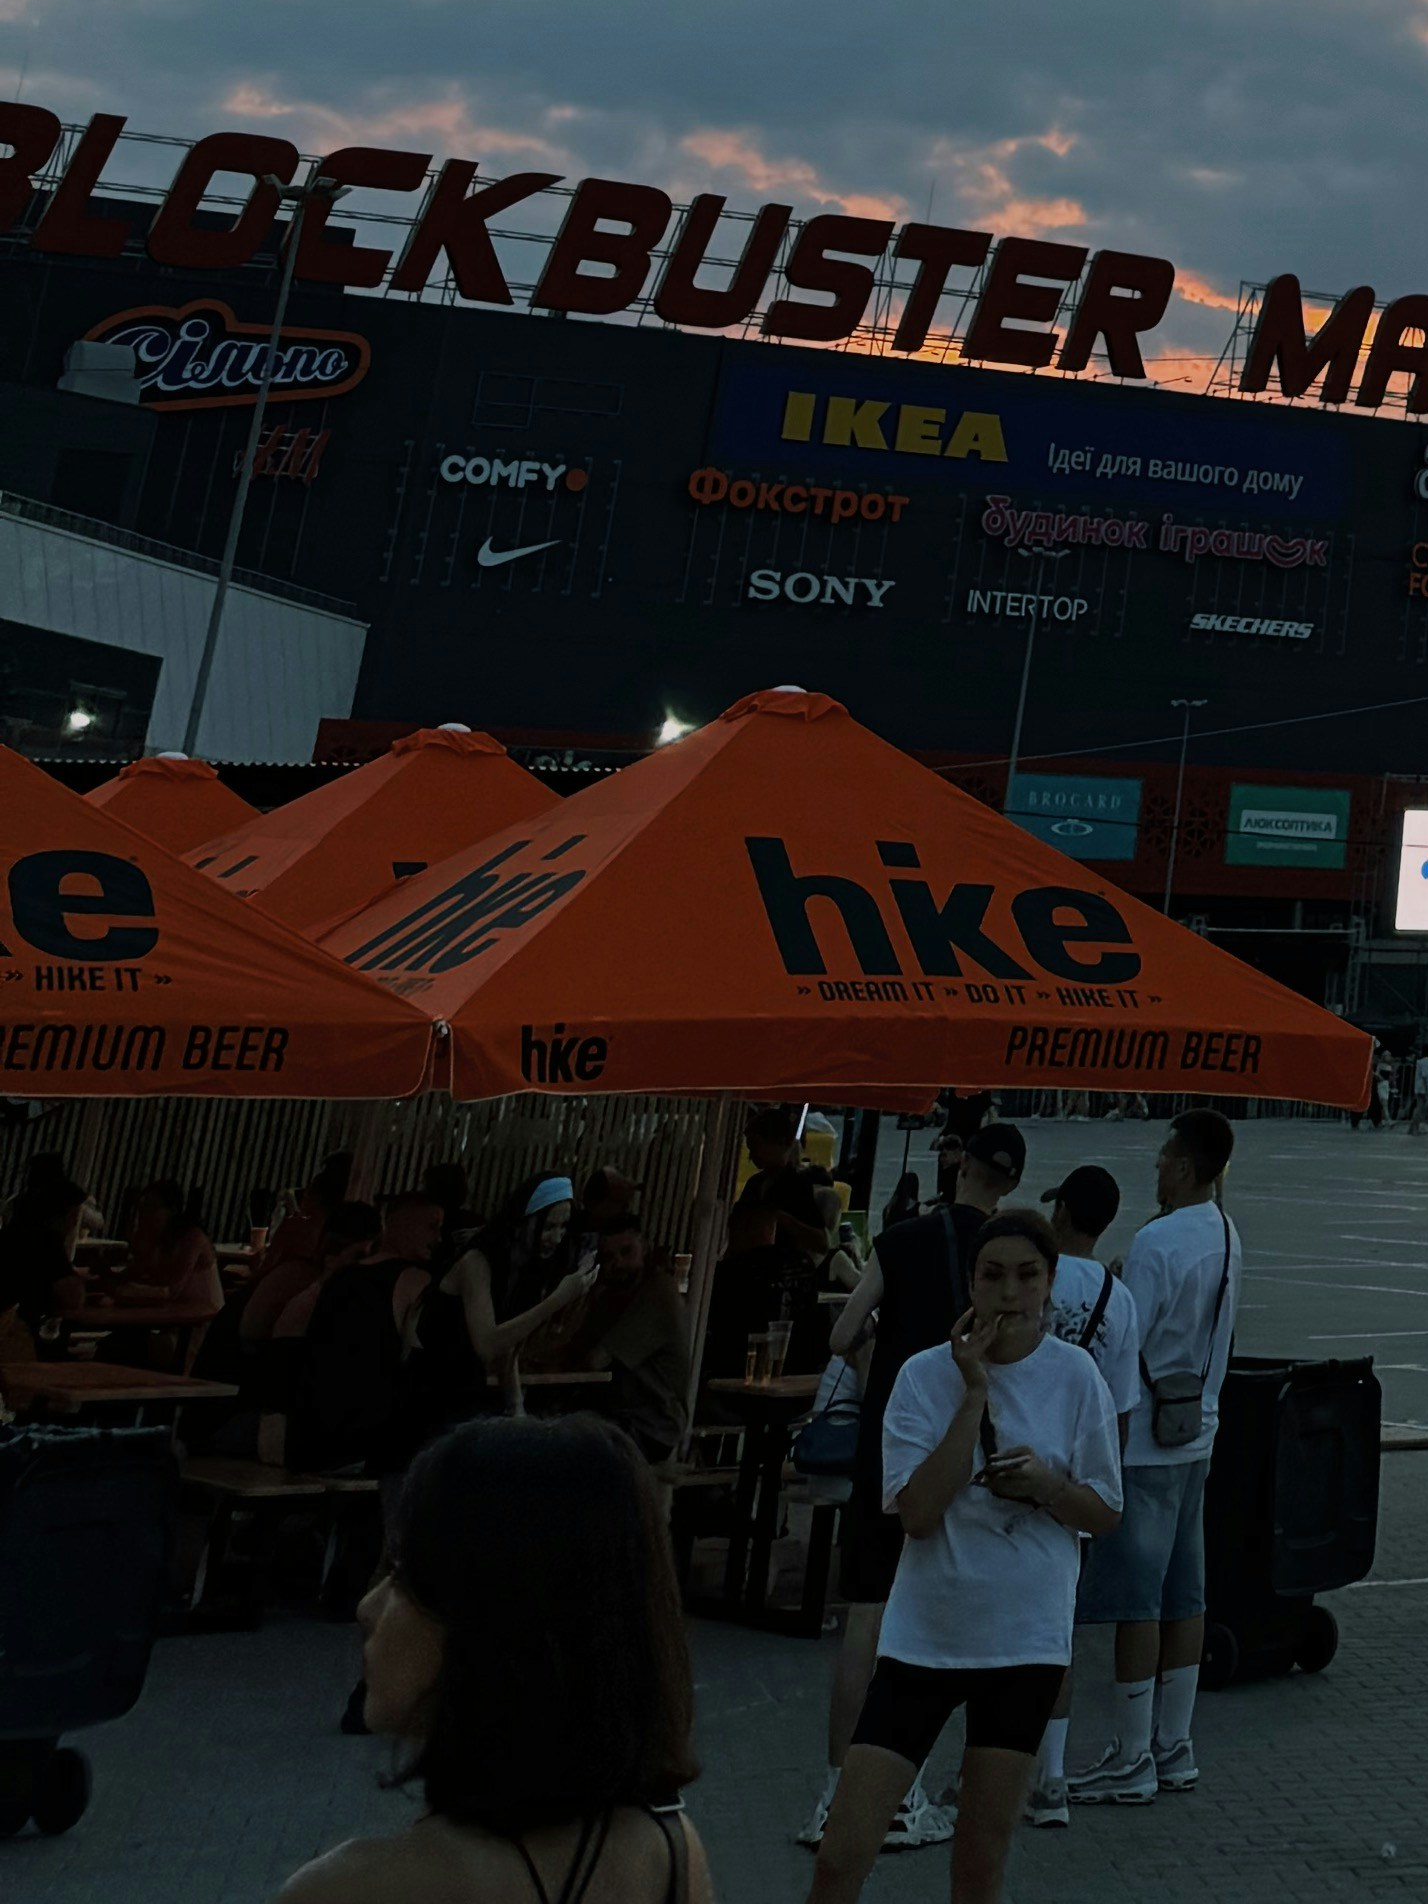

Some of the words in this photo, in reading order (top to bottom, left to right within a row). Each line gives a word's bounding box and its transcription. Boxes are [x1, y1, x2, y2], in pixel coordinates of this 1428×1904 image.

[0, 101, 1176, 379] BLOCKBUSTER
[780, 390, 1009, 463] IKEA
[439, 454, 567, 491] COMFY
[687, 466, 911, 525] Фокстрот
[1048, 442, 1093, 475] Ідеї
[1096, 451, 1142, 479] для
[1149, 457, 1239, 488] вашого
[1241, 469, 1305, 501] дому
[981, 494, 1151, 549] будинок
[747, 568, 896, 608] SONY
[966, 589, 1089, 622] INTERTOP
[1189, 612, 1316, 640] SKECHERS
[1028, 791, 1122, 810] BROCARD
[342, 834, 588, 974] hike
[745, 836, 1142, 985] hike
[35, 965, 105, 992] HIKE
[113, 967, 143, 993] IT
[819, 979, 909, 1003] DREAM
[912, 981, 935, 1002] IT
[965, 983, 1000, 1004] DO
[1003, 985, 1028, 1006] IT
[1057, 986, 1114, 1008] HIKE
[1117, 988, 1140, 1009] IT
[0, 1024, 166, 1072] EMIUM
[182, 1025, 290, 1073] BEER
[521, 1022, 608, 1084] hike
[1004, 1026, 1170, 1071] PREMIUM
[1180, 1031, 1263, 1074] BEER
